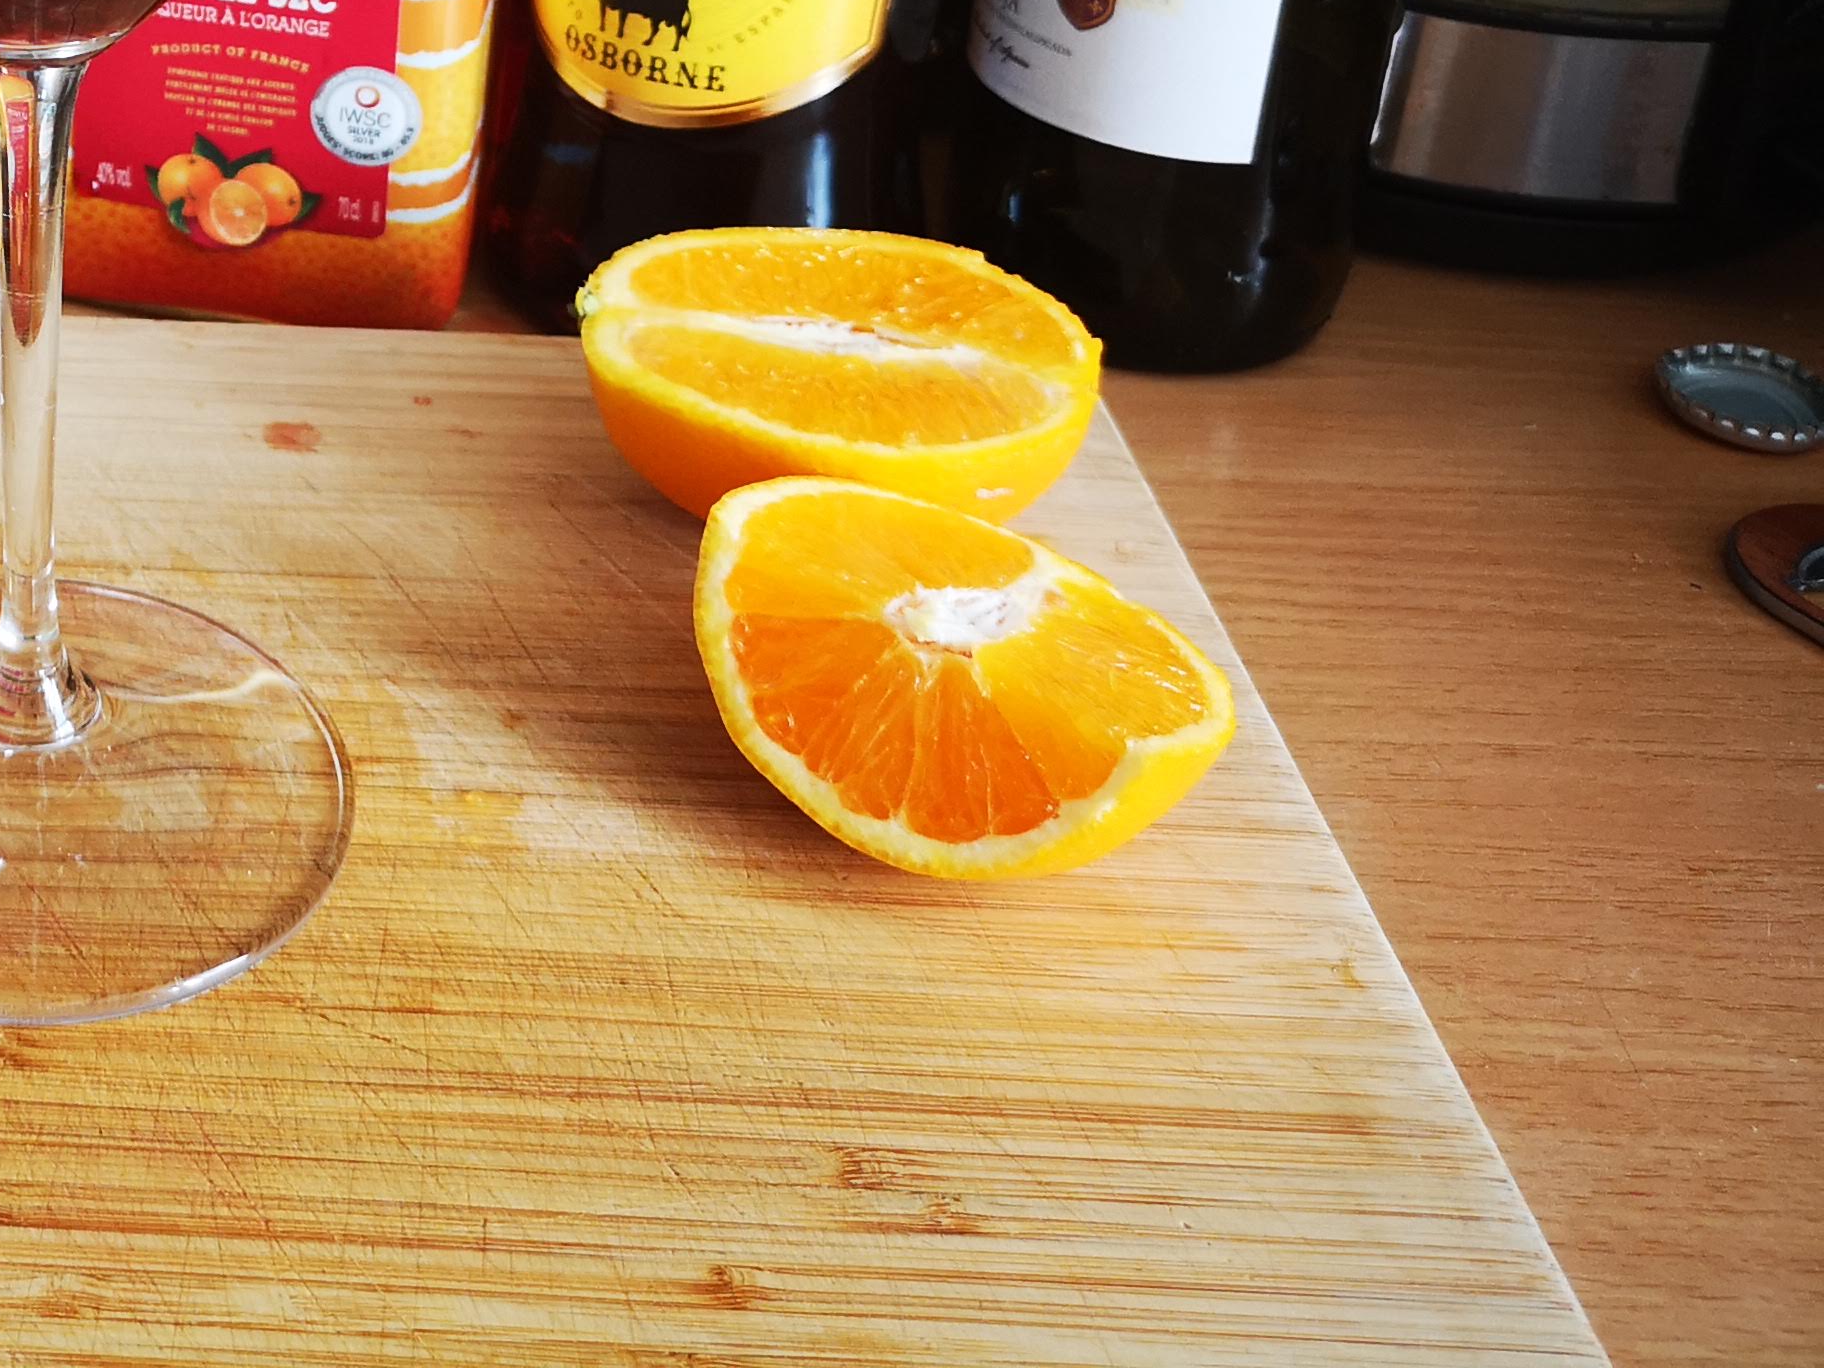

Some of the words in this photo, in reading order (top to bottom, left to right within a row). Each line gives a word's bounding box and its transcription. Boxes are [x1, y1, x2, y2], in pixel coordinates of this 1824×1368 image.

[220, 5, 236, 26] À
[239, 10, 332, 38] L'ORANGE
[150, 43, 222, 56] PRODUCT
[225, 45, 246, 58] OF
[250, 48, 311, 75] FRANCE
[565, 23, 727, 94] OSBORNE
[339, 107, 392, 129] IWSC
[347, 125, 382, 138] SILVER
